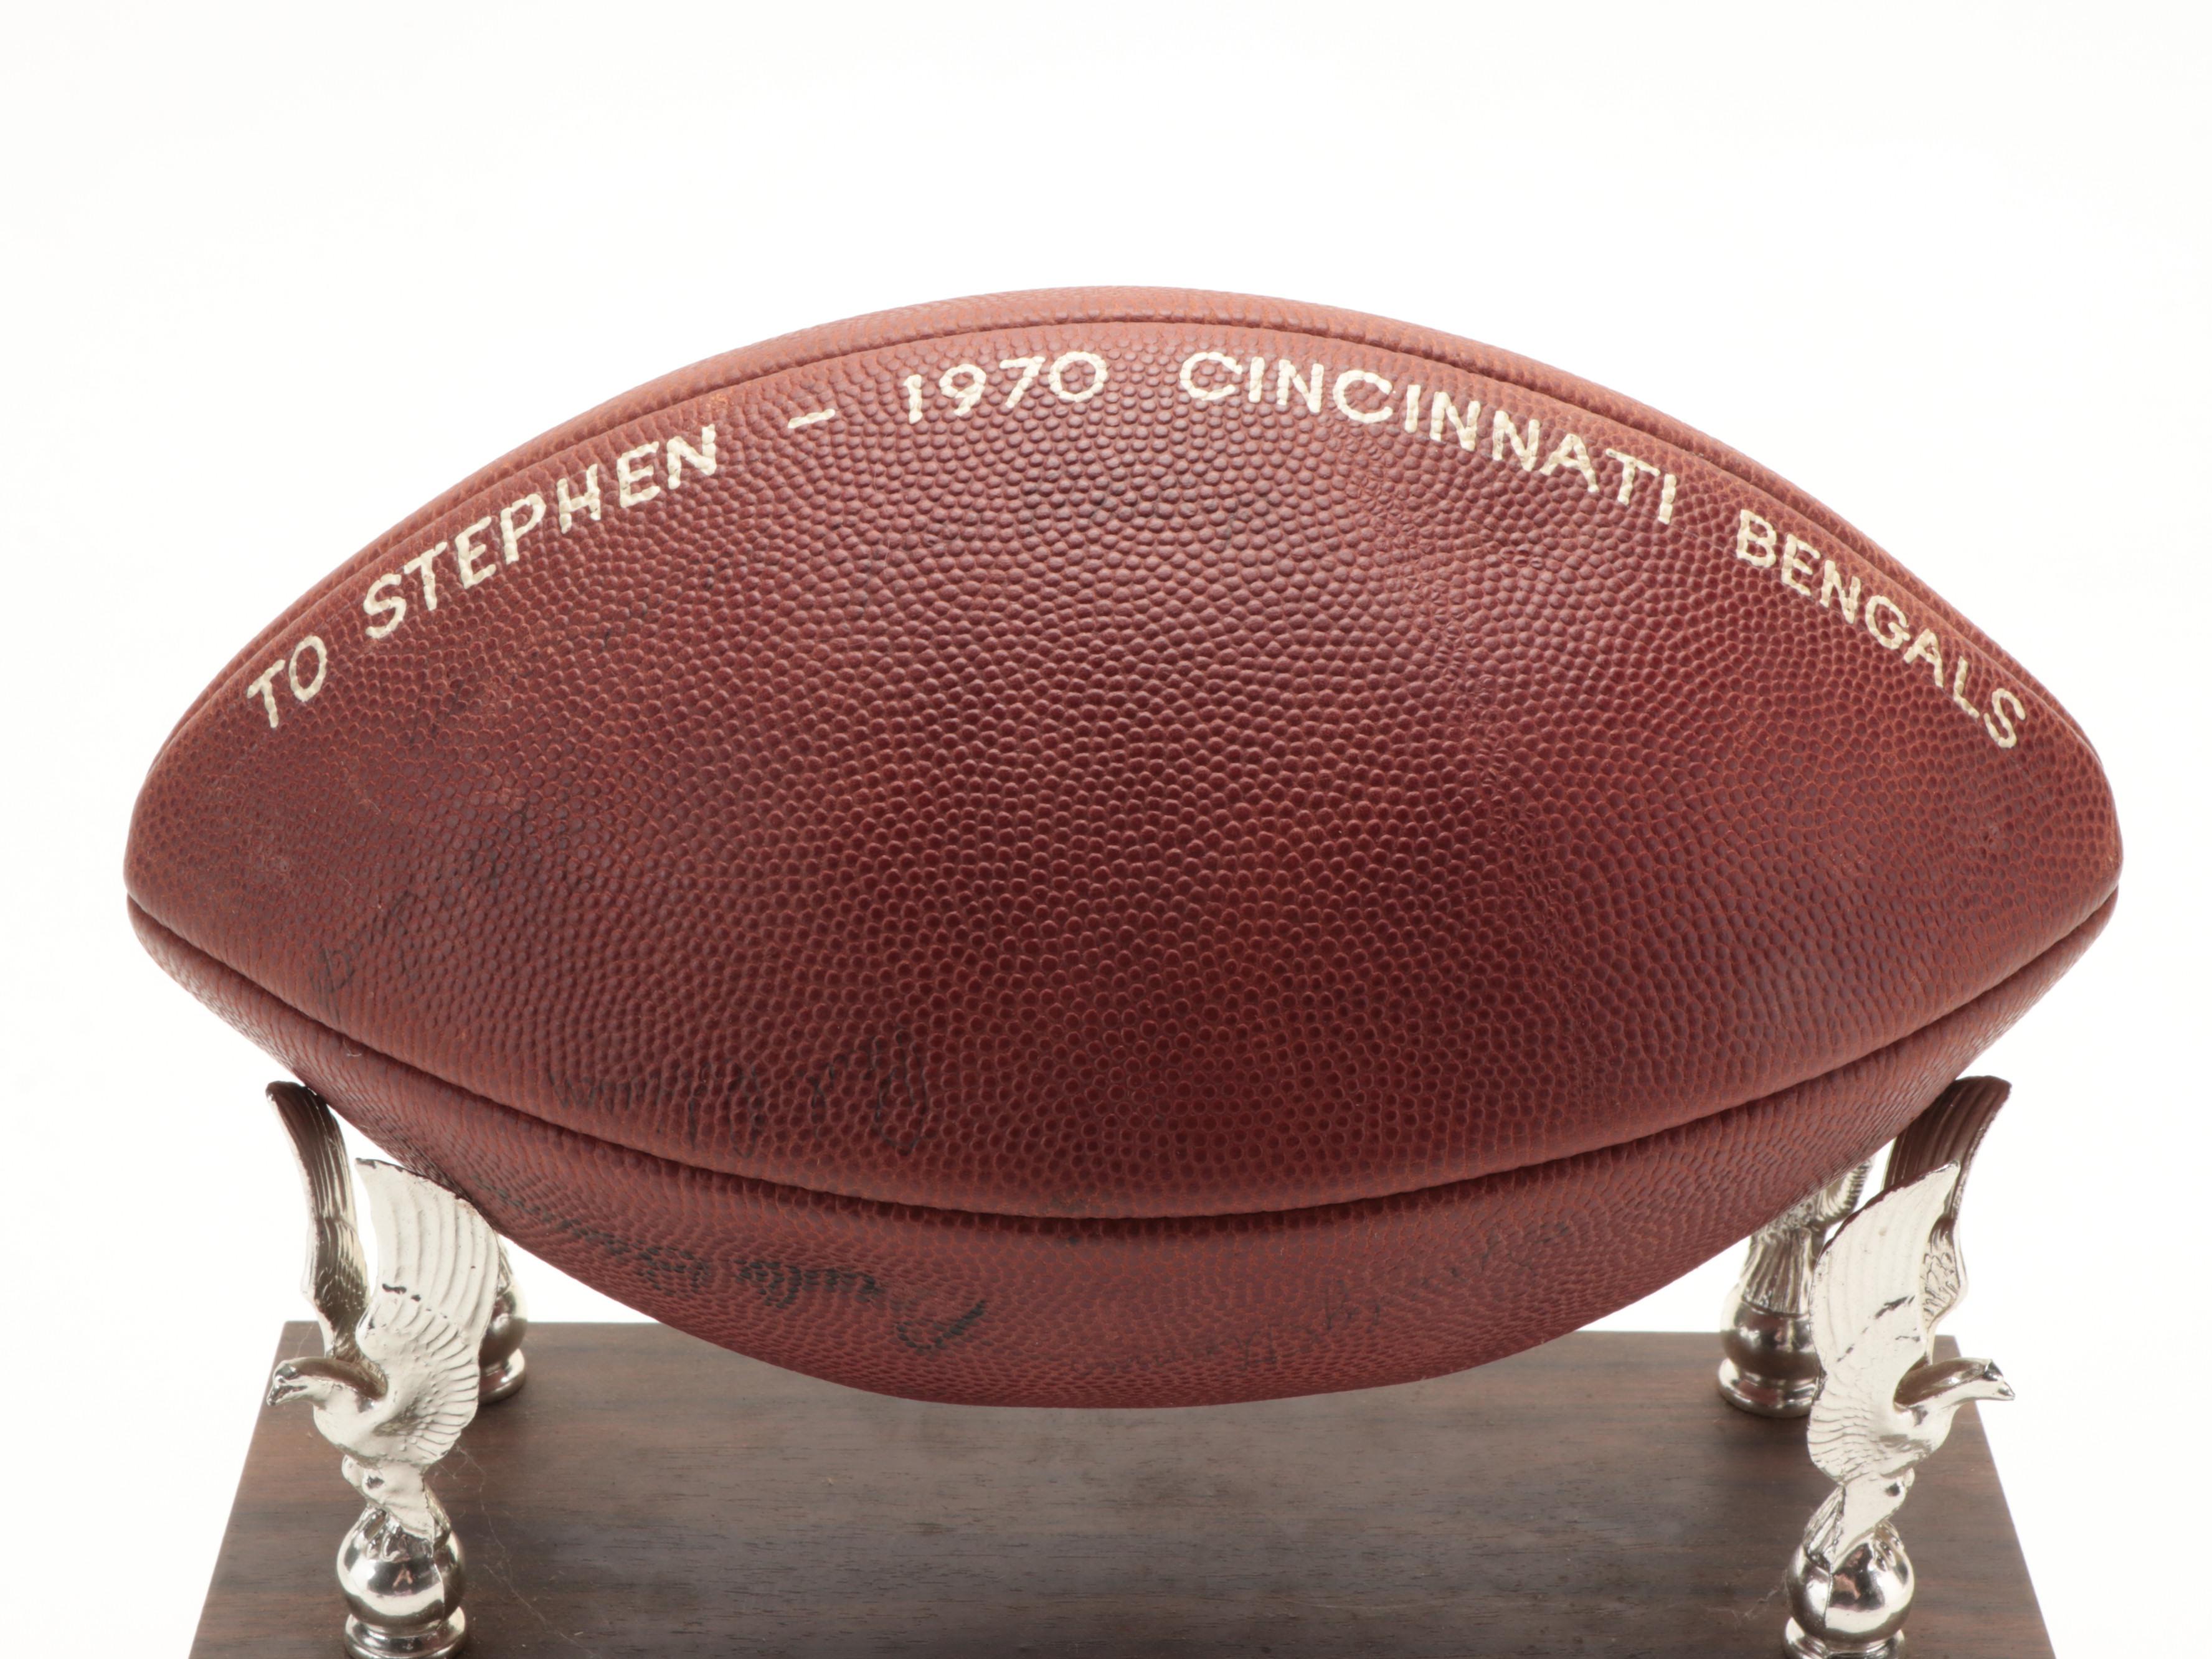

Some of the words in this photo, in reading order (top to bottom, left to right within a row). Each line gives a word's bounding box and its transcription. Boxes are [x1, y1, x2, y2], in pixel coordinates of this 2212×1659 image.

[247, 635, 328, 729] TO
[363, 423, 717, 640] STEPHEN
[904, 351, 1108, 424] 1970
[1179, 352, 1676, 524] CINCINNATI
[1736, 509, 2026, 748] BENGALS
